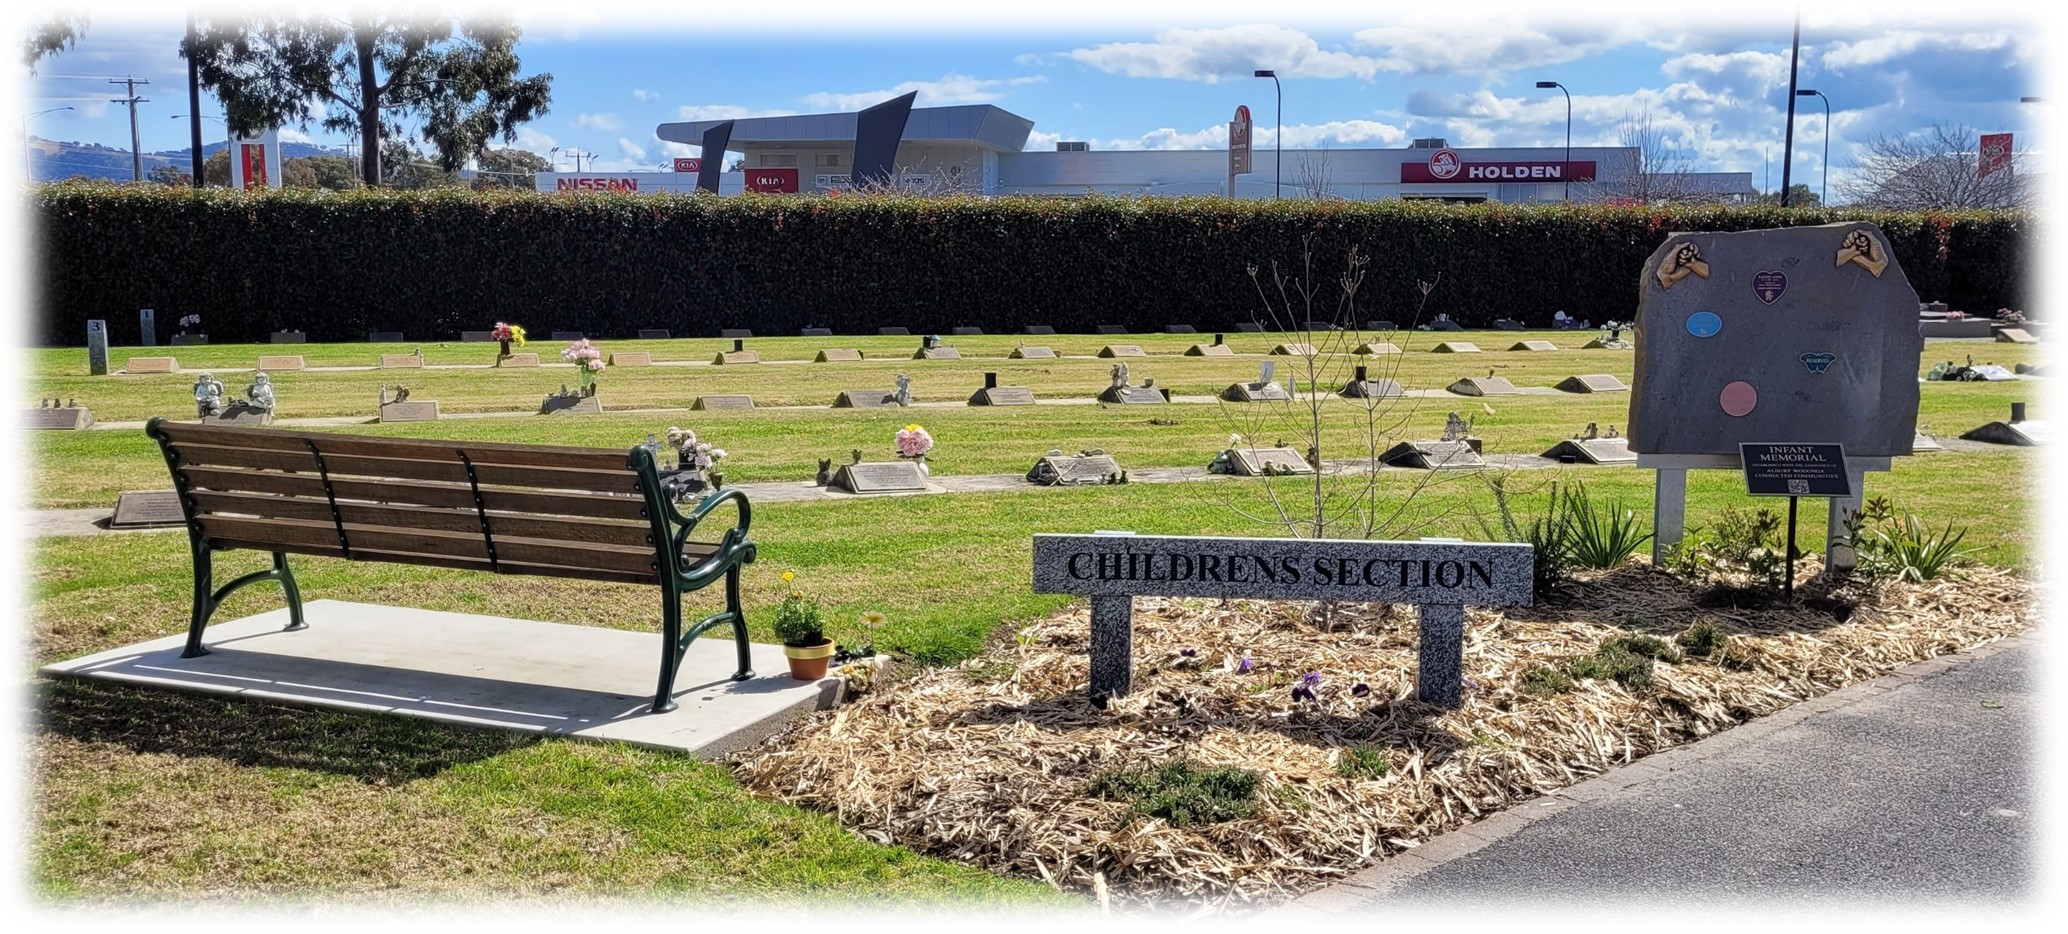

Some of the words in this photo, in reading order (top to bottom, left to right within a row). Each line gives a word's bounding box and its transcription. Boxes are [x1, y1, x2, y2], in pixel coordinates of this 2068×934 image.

[1469, 166, 1561, 178] HOLDEN
[557, 177, 638, 191] NISSAN
[760, 177, 780, 185] KIA
[92, 322, 100, 331] 3
[1067, 552, 1301, 584] CHILDRENS
[1313, 556, 1495, 590] SECTION
